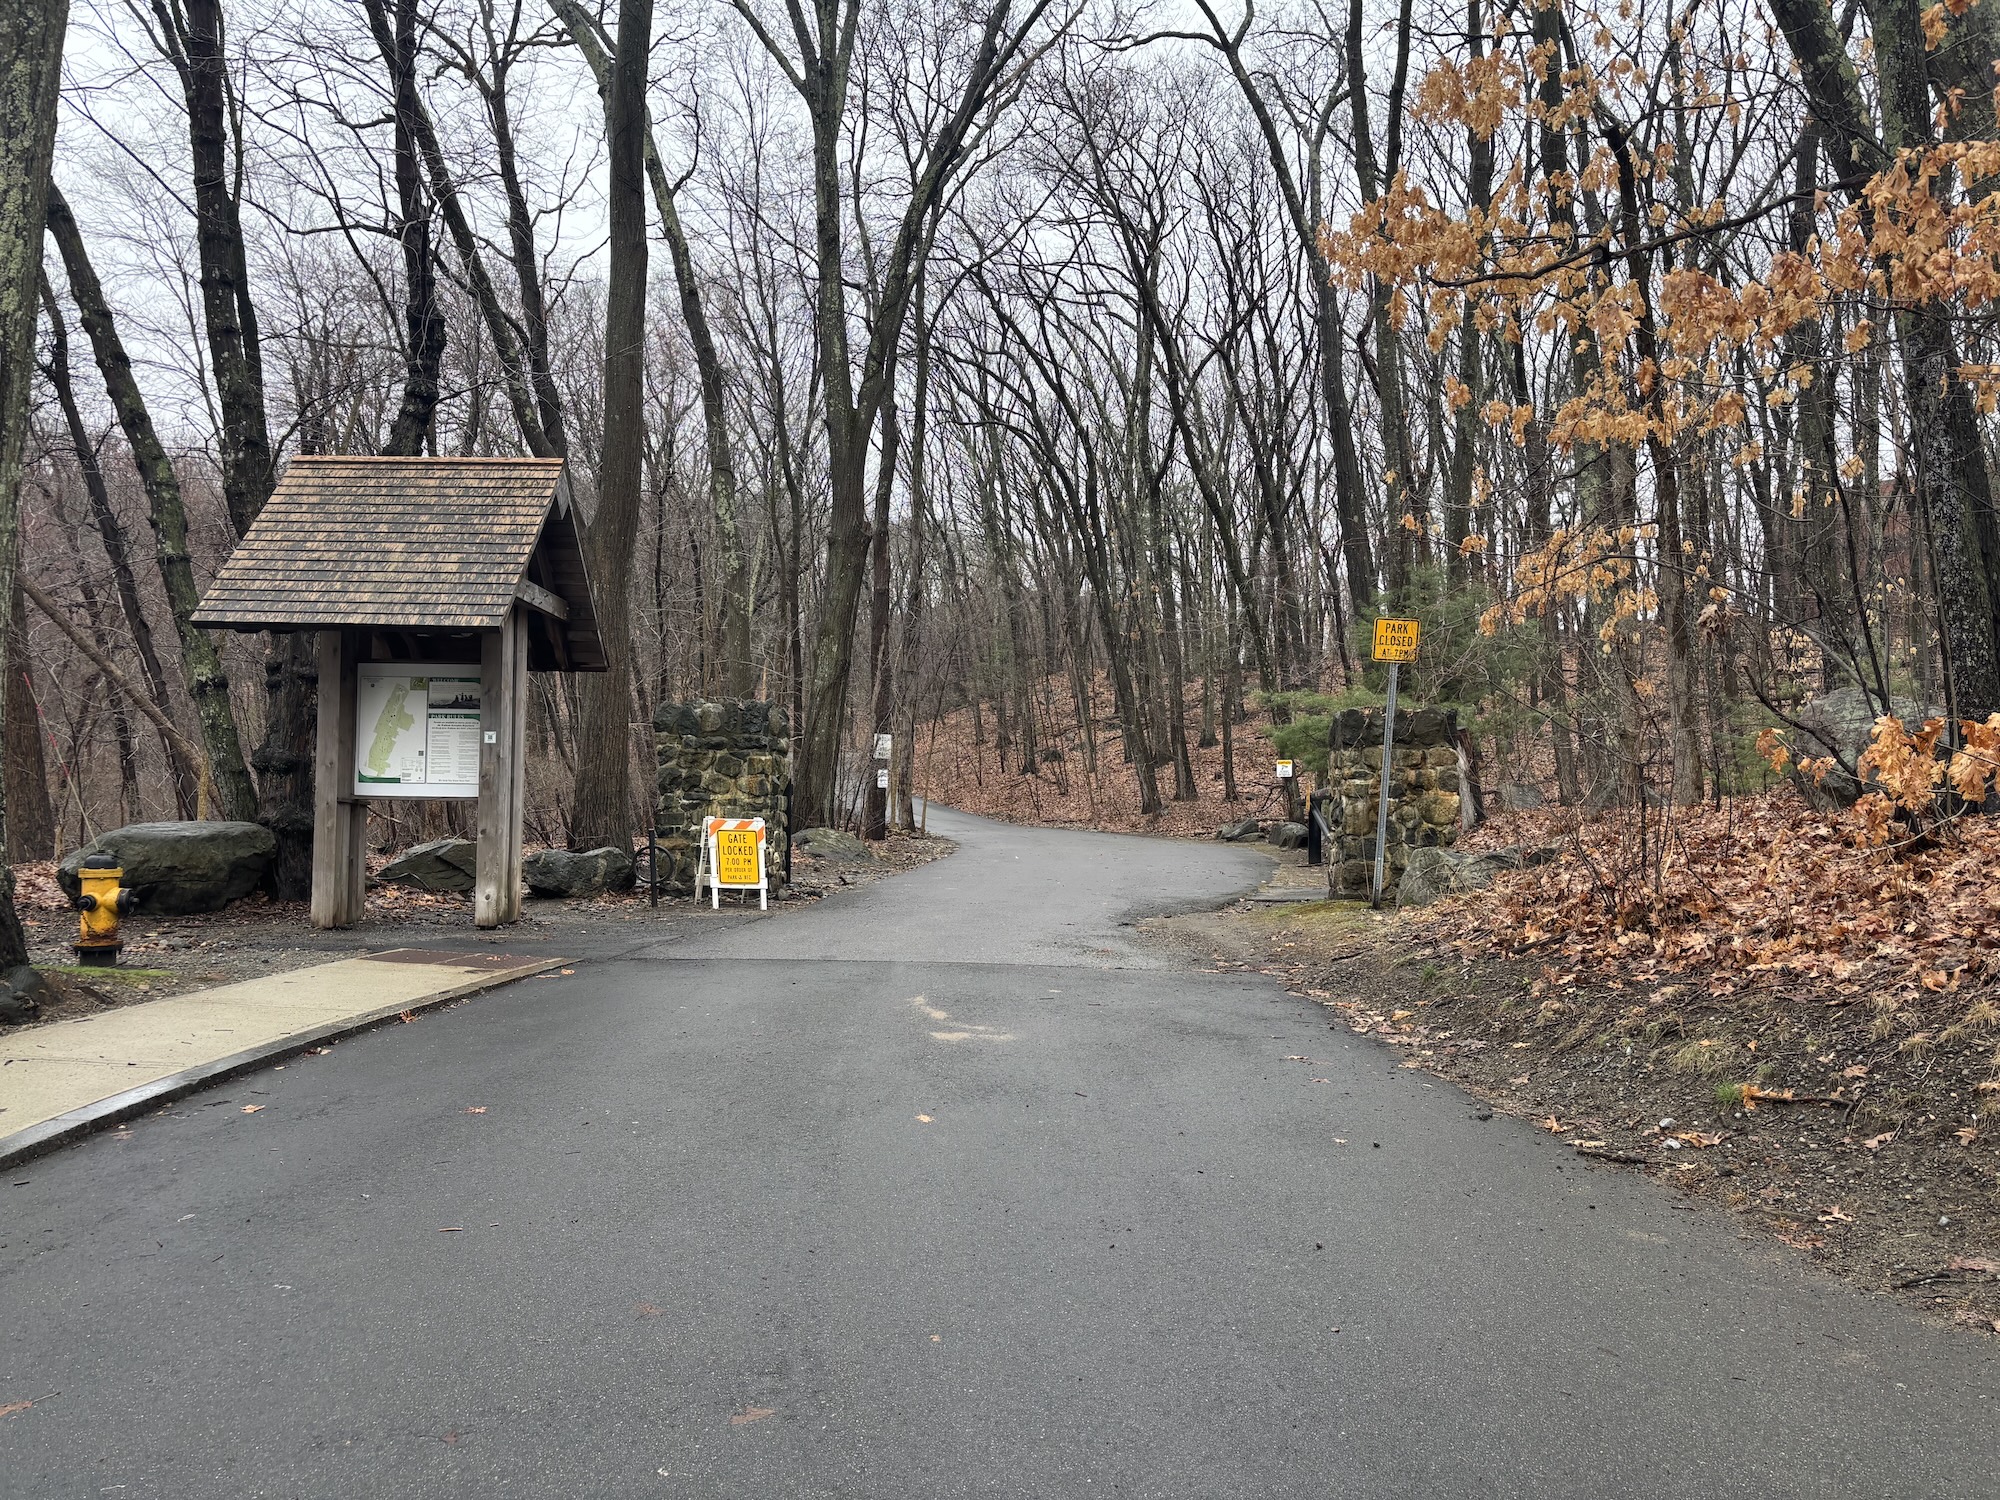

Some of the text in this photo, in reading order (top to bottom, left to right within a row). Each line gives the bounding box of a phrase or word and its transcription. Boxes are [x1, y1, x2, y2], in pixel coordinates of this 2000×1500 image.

[1385, 623, 1409, 634] PARK
[1379, 635, 1413, 647] CLOSED
[1382, 648, 1390, 657] AT
[728, 834, 747, 843] GATE
[722, 846, 753, 855] LOCKED
